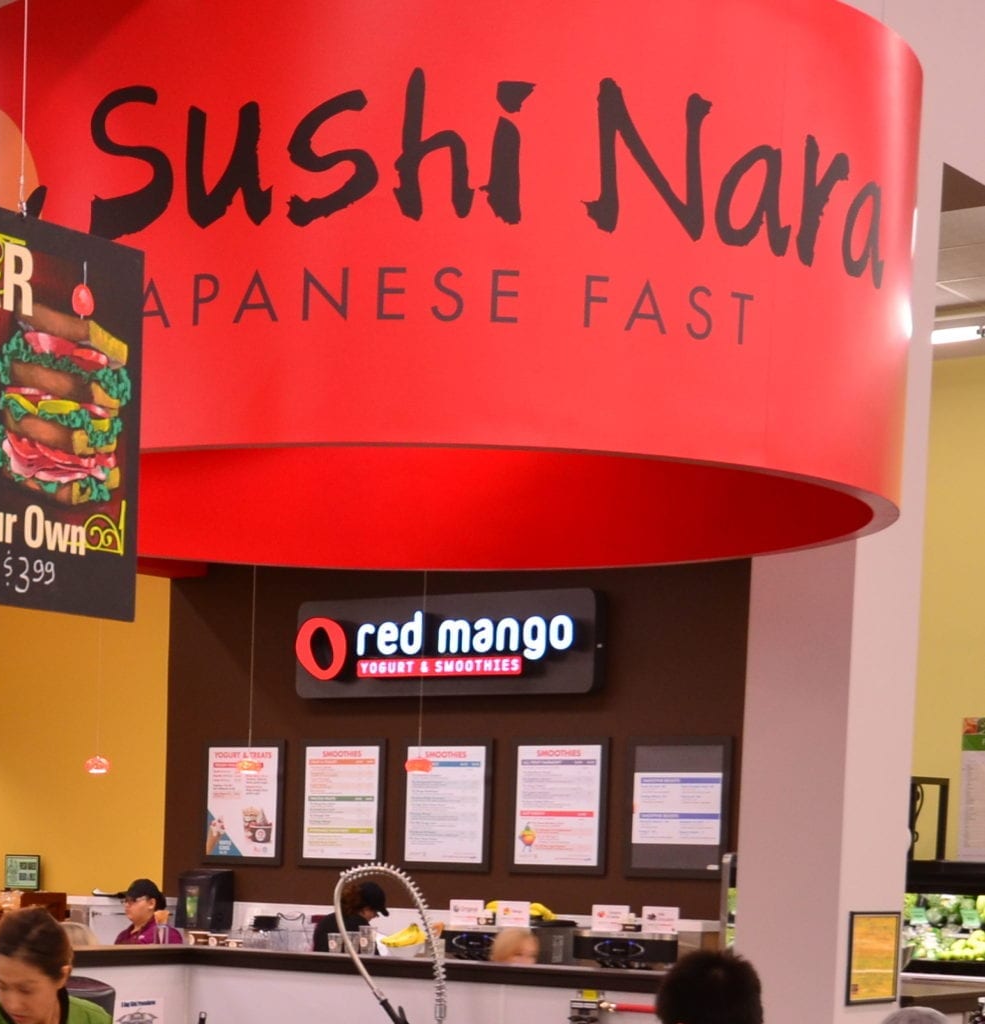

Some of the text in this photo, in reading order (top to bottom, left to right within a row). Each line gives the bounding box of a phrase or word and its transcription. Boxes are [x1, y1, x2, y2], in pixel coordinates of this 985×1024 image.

[90, 67, 885, 289] Sushi Nara
[142, 266, 754, 345] APANESE FAST
[24, 505, 86, 556] Own
[356, 611, 574, 660] red mango
[360, 658, 520, 675] YOGURT & SMOOTHIES
